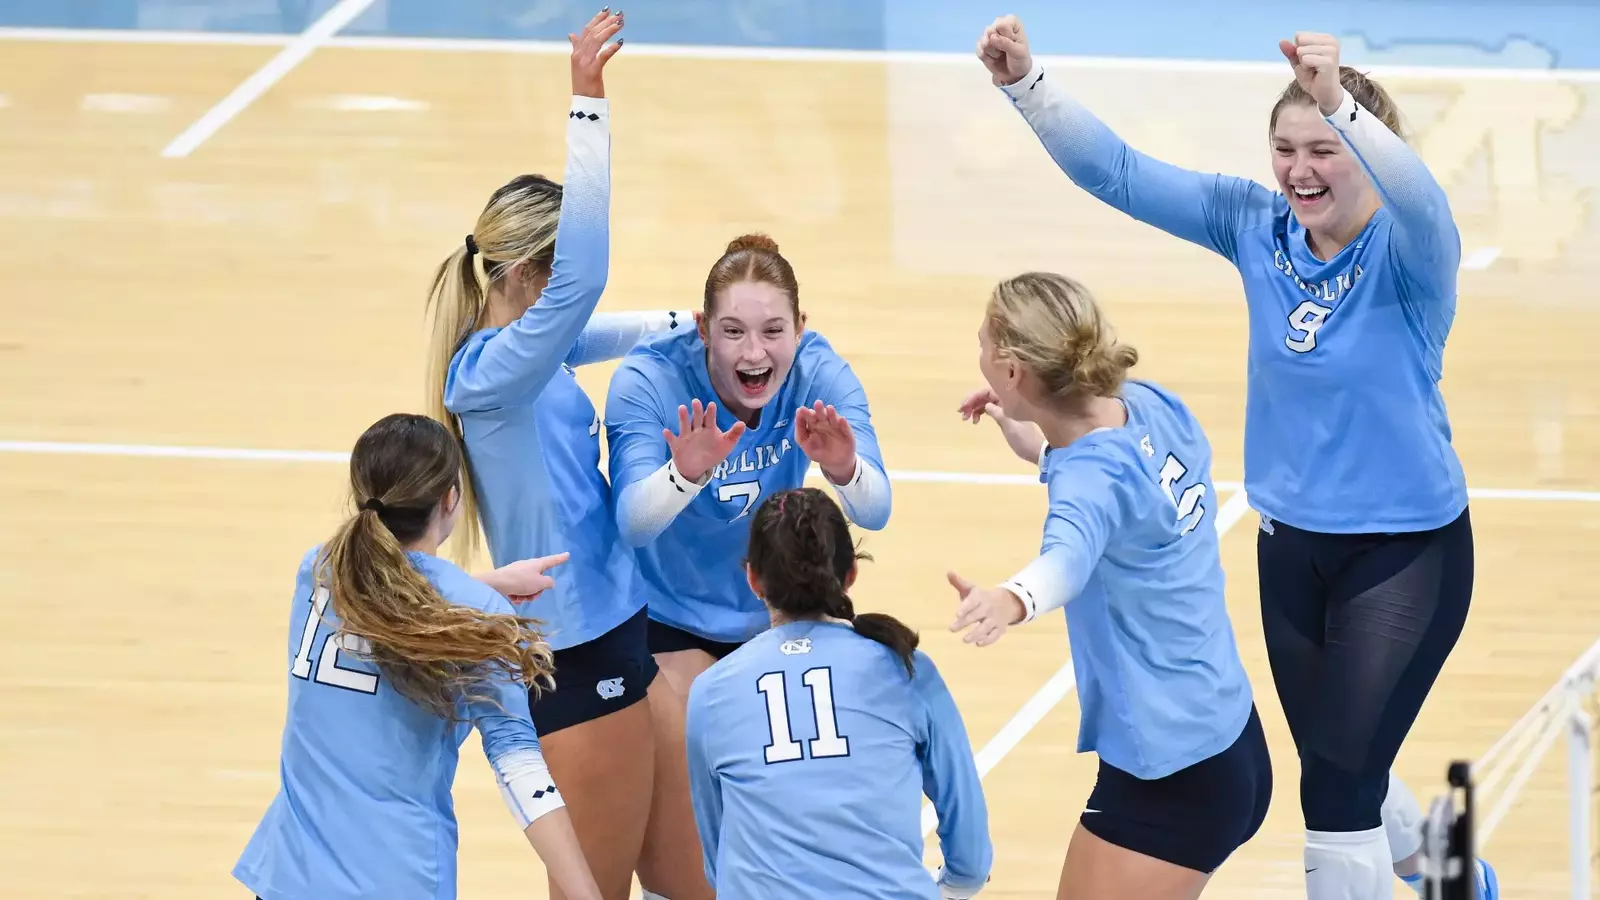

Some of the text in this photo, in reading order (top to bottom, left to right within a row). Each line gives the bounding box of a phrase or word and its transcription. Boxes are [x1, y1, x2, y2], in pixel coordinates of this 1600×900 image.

[1285, 300, 1332, 353] 9
[711, 438, 792, 481] RLINA
[1159, 451, 1207, 538] 5
[718, 480, 762, 524] 7
[291, 584, 380, 695] 12
[756, 666, 850, 765] 11
